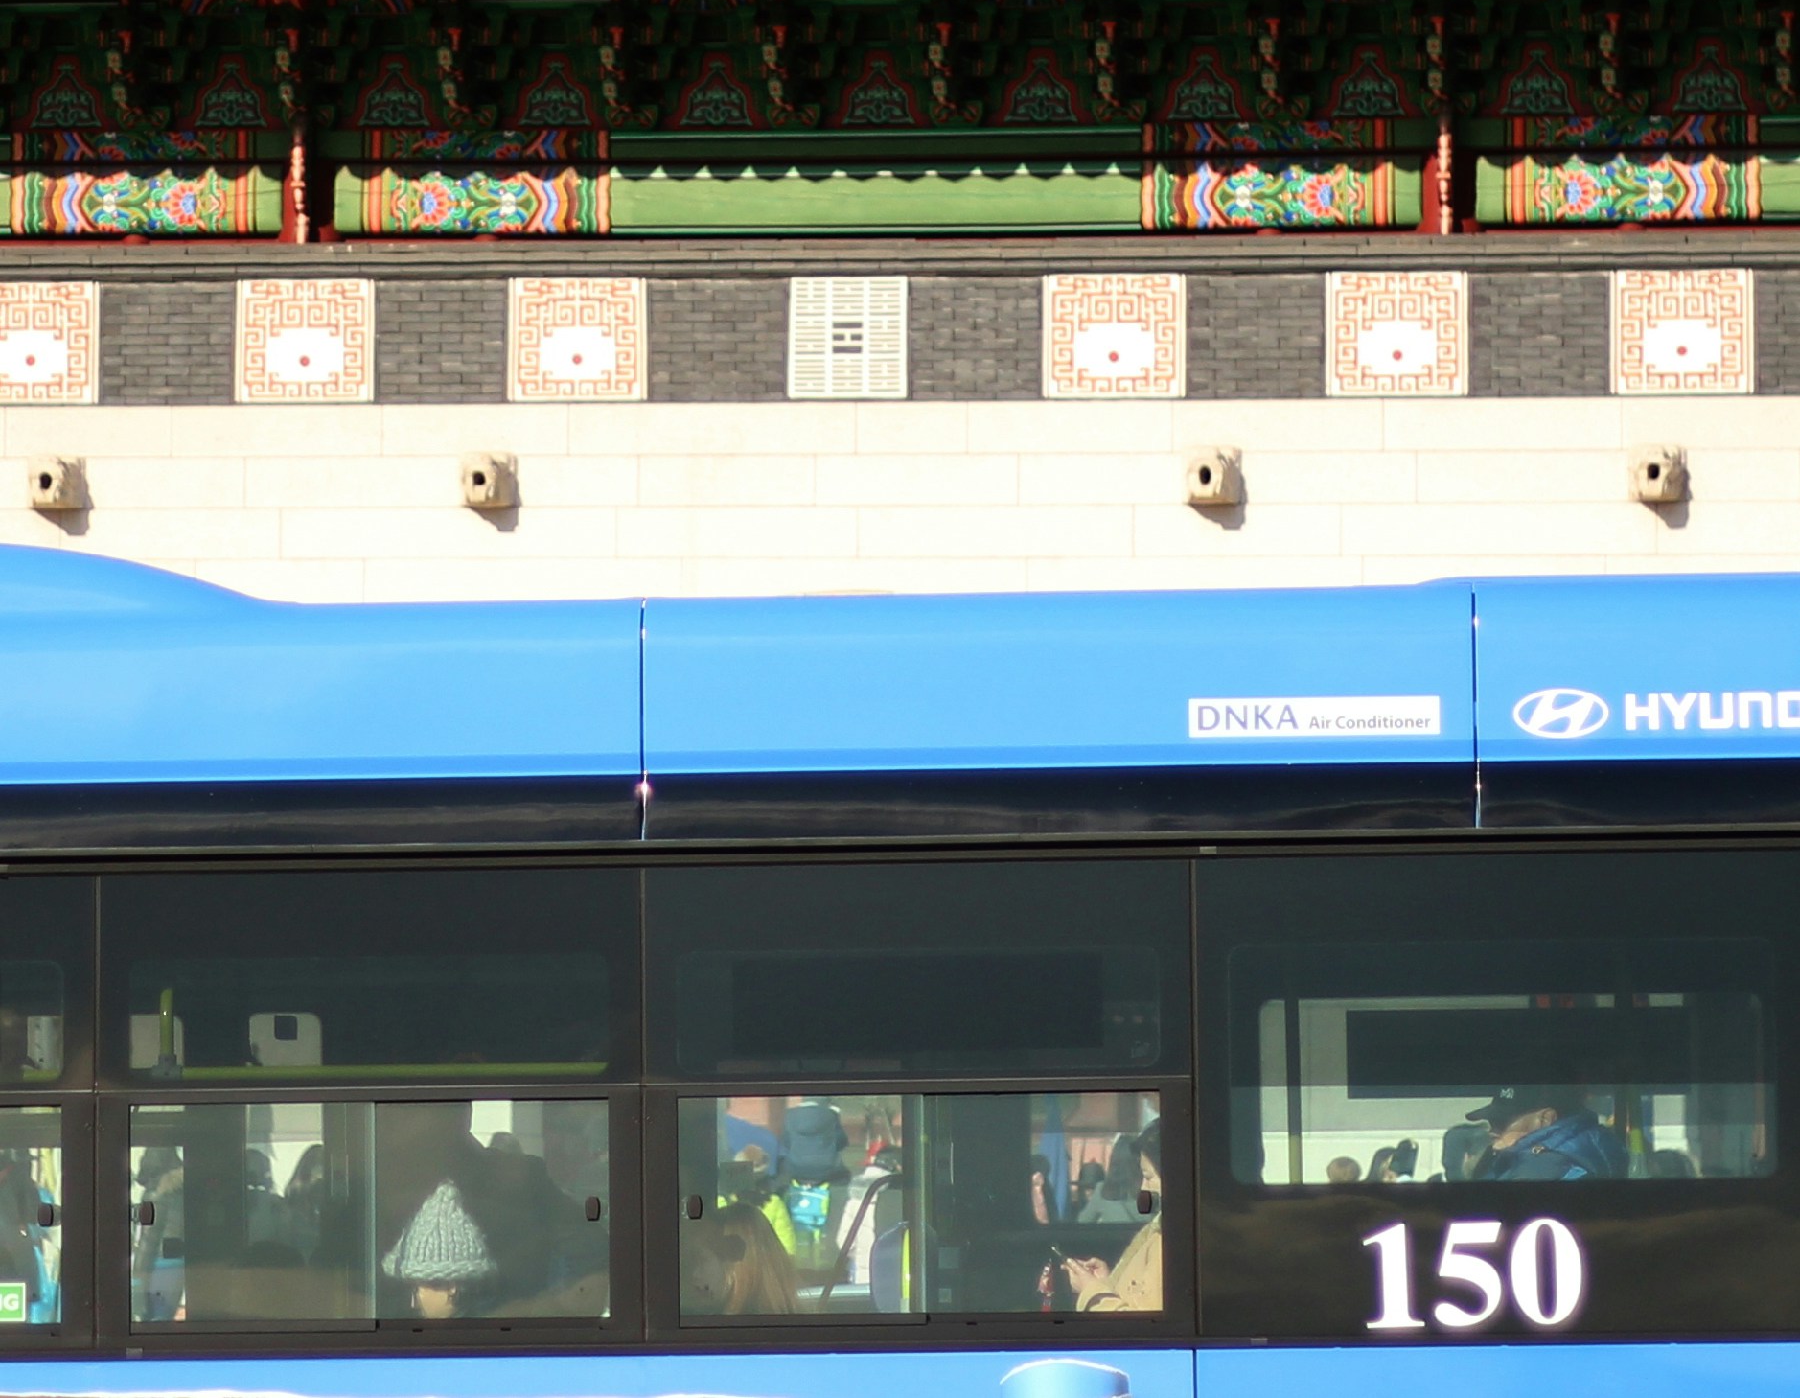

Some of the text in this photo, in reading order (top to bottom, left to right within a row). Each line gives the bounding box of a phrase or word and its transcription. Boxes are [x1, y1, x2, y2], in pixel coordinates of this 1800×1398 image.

[1197, 704, 1431, 731] DNKA Air Conditioner
[1362, 1217, 1583, 1330] 150
[0, 1292, 19, 1312] G
